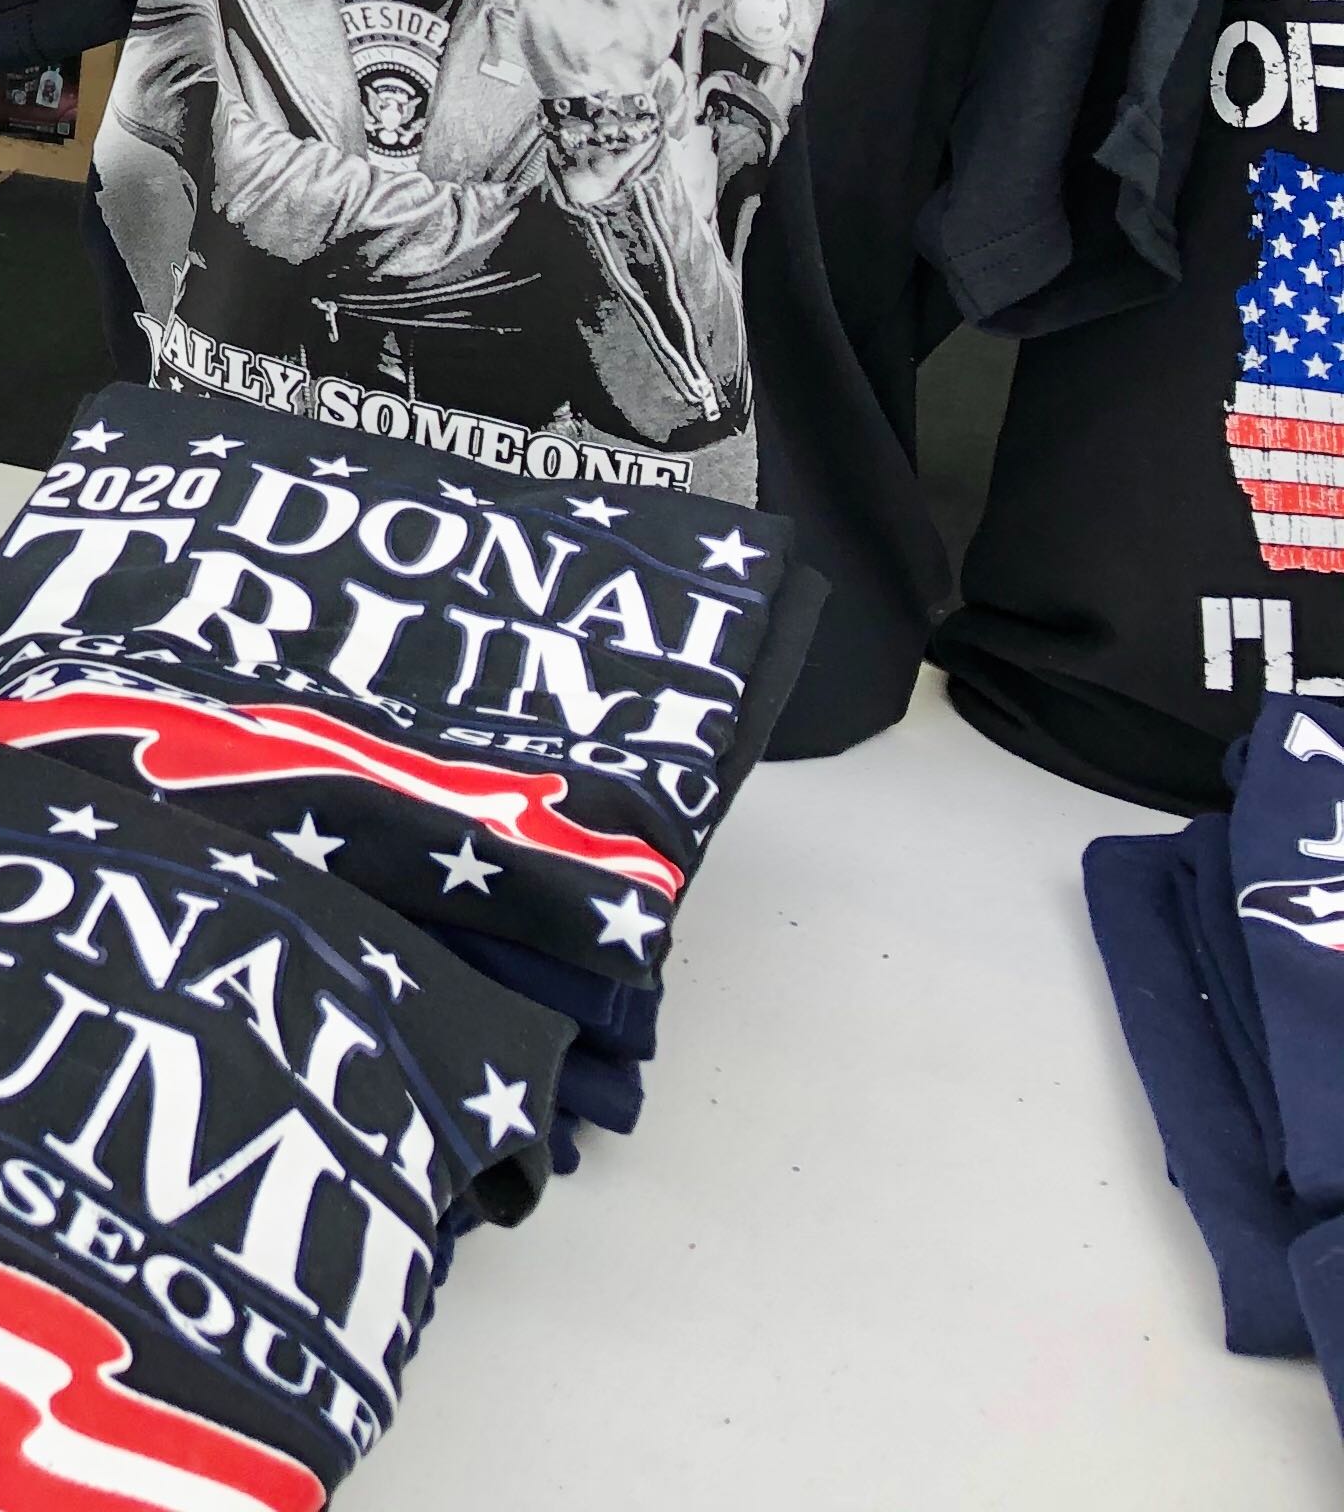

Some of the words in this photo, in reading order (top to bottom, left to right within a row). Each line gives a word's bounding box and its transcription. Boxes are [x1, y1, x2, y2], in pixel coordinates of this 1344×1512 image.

[341, 4, 444, 45] RESIDE
[315, 376, 694, 494] SOMEONE
[28, 461, 224, 514] 2020
[219, 461, 748, 683] DONAL
[222, 662, 418, 730] THE
[438, 726, 720, 820] SEQU
